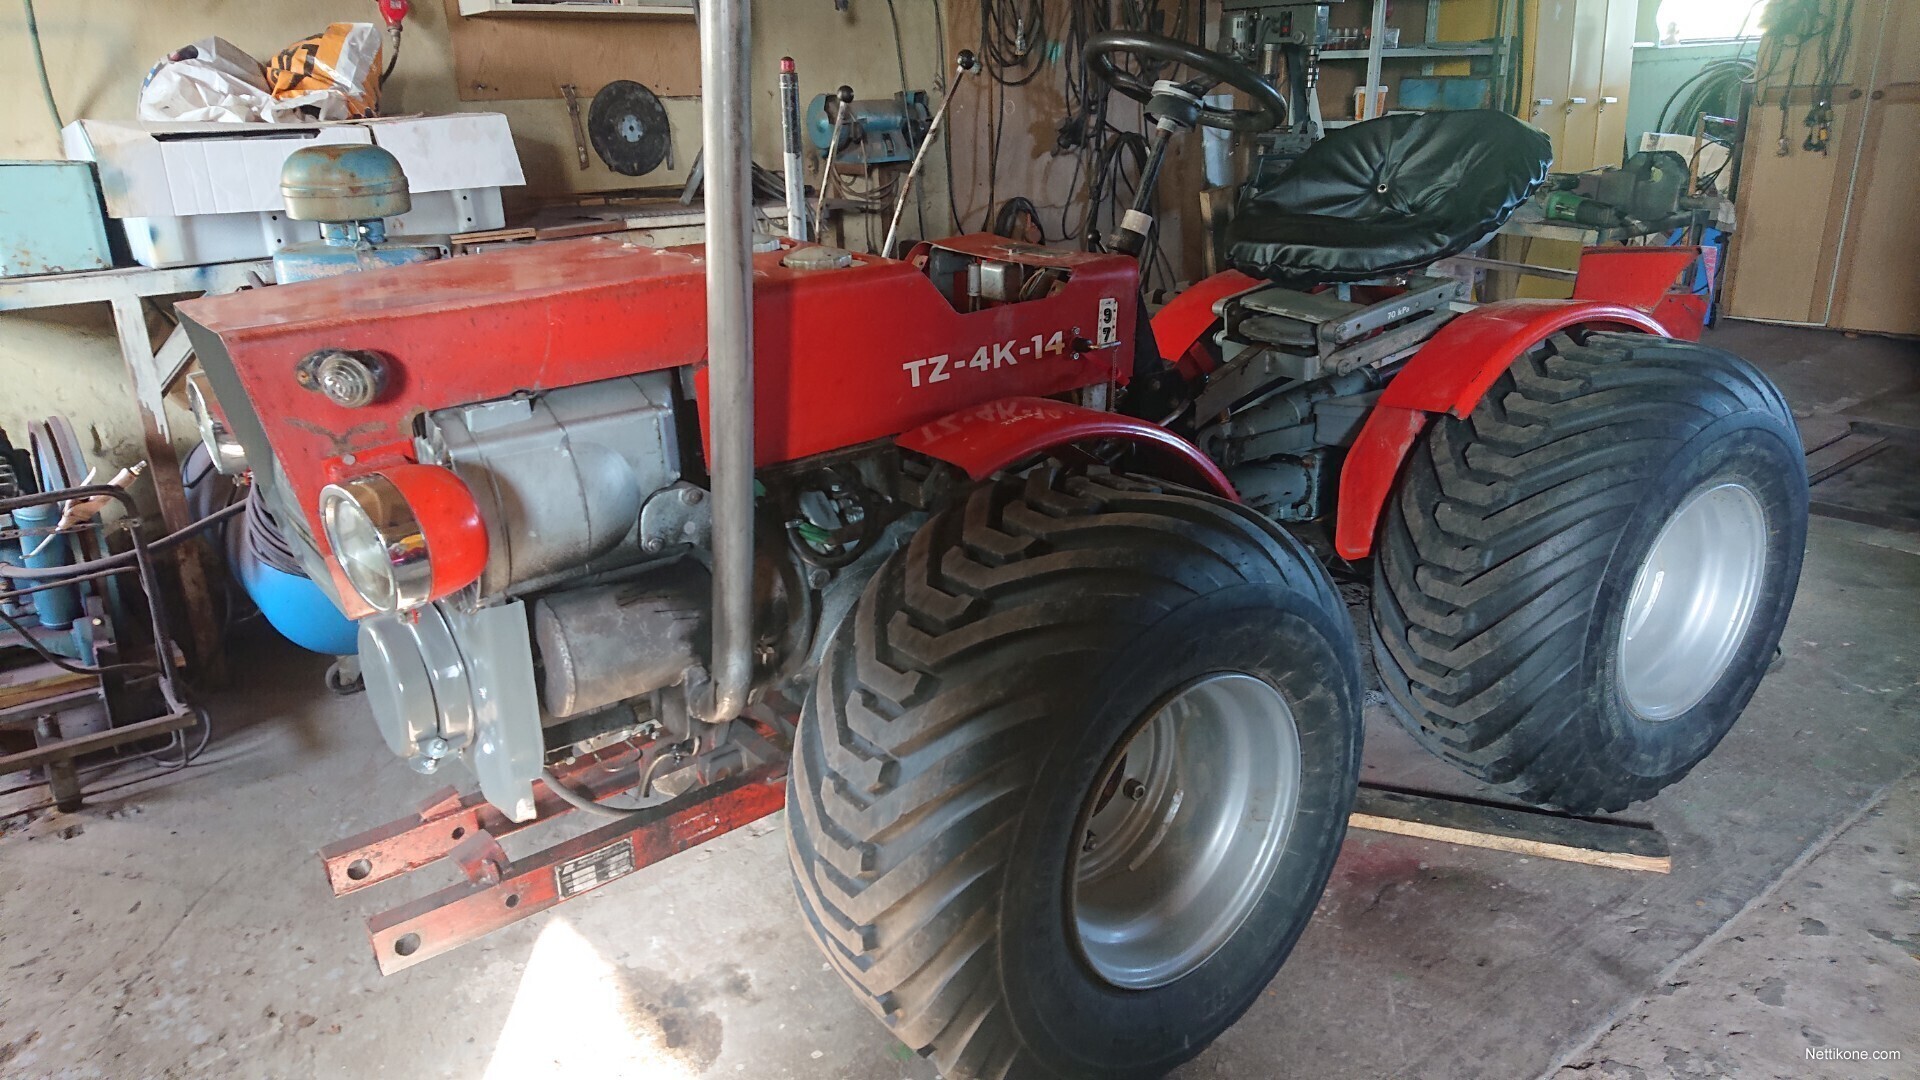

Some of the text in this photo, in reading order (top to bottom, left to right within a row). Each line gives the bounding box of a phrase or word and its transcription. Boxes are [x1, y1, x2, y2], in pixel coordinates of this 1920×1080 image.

[1388, 306, 1410, 320] 70 kPa
[903, 331, 1065, 388] TZ-4K-14
